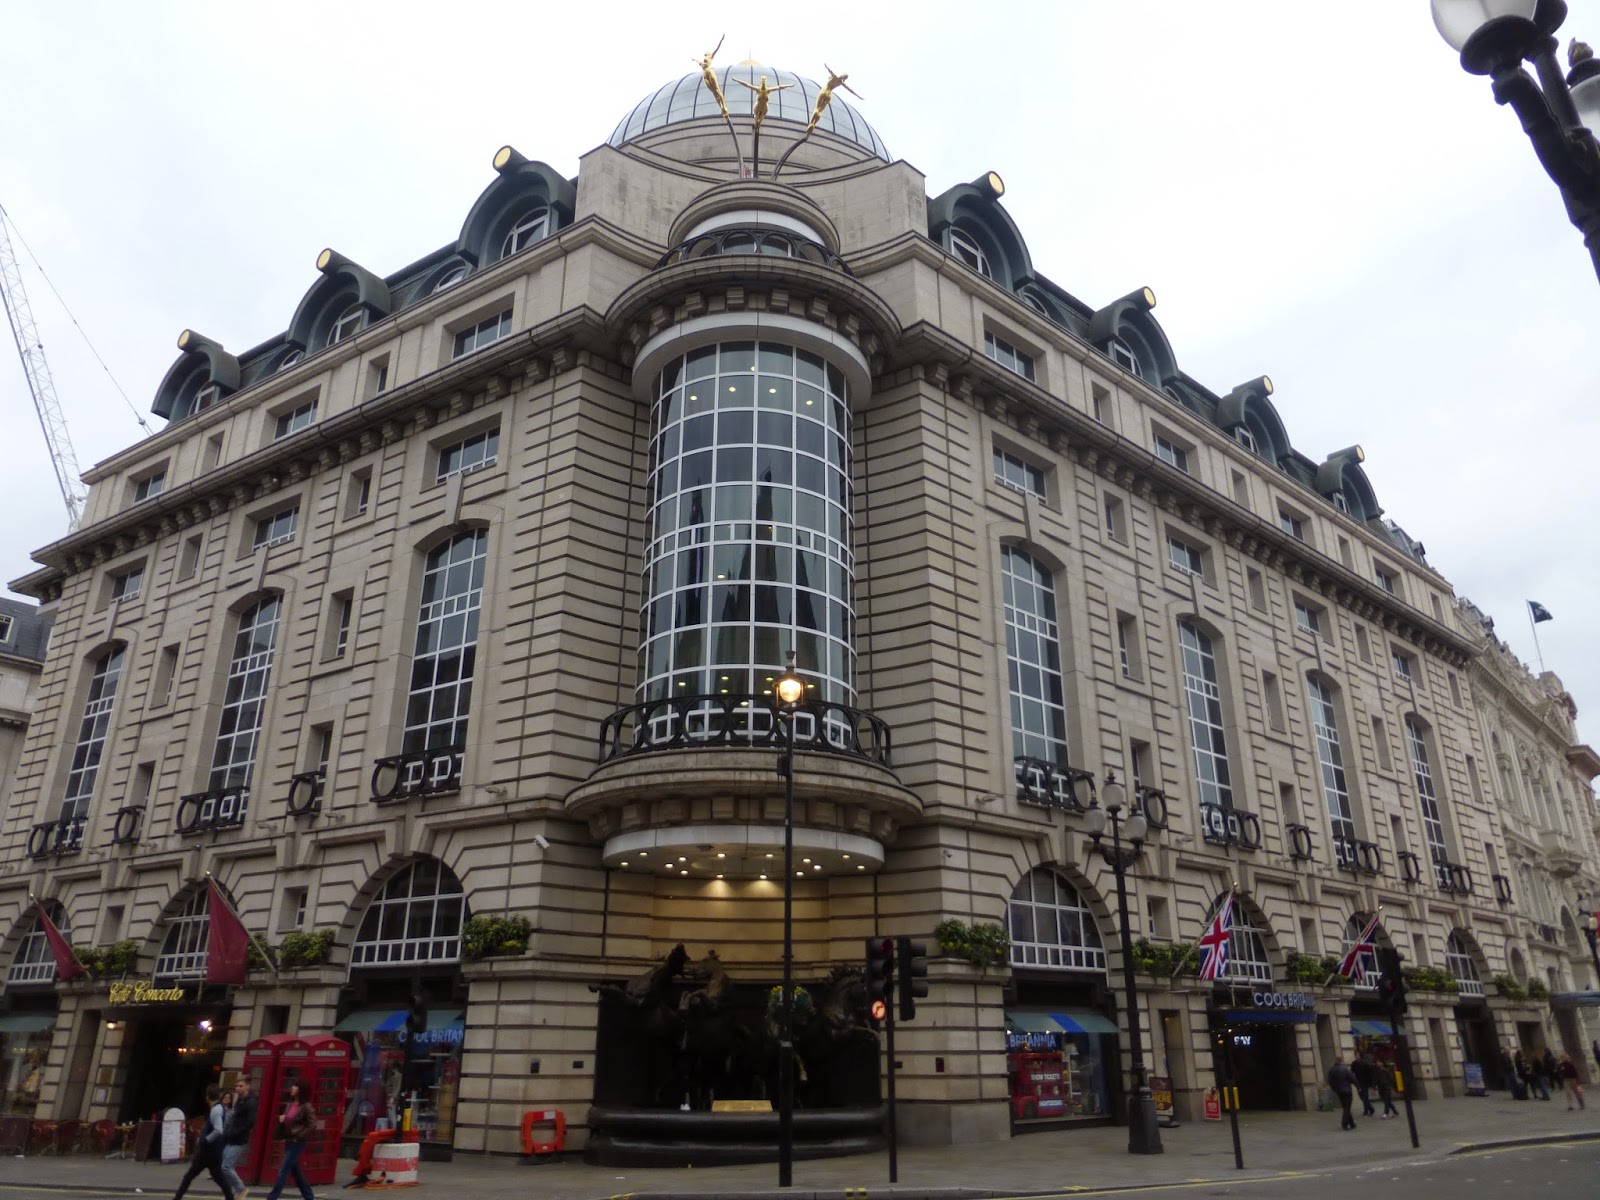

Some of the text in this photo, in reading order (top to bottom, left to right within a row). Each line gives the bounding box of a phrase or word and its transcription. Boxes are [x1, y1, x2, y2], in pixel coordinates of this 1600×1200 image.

[134, 980, 185, 1003] Concerto
[1253, 992, 1316, 1008] COOL BRITA
[398, 1029, 430, 1043] COL
